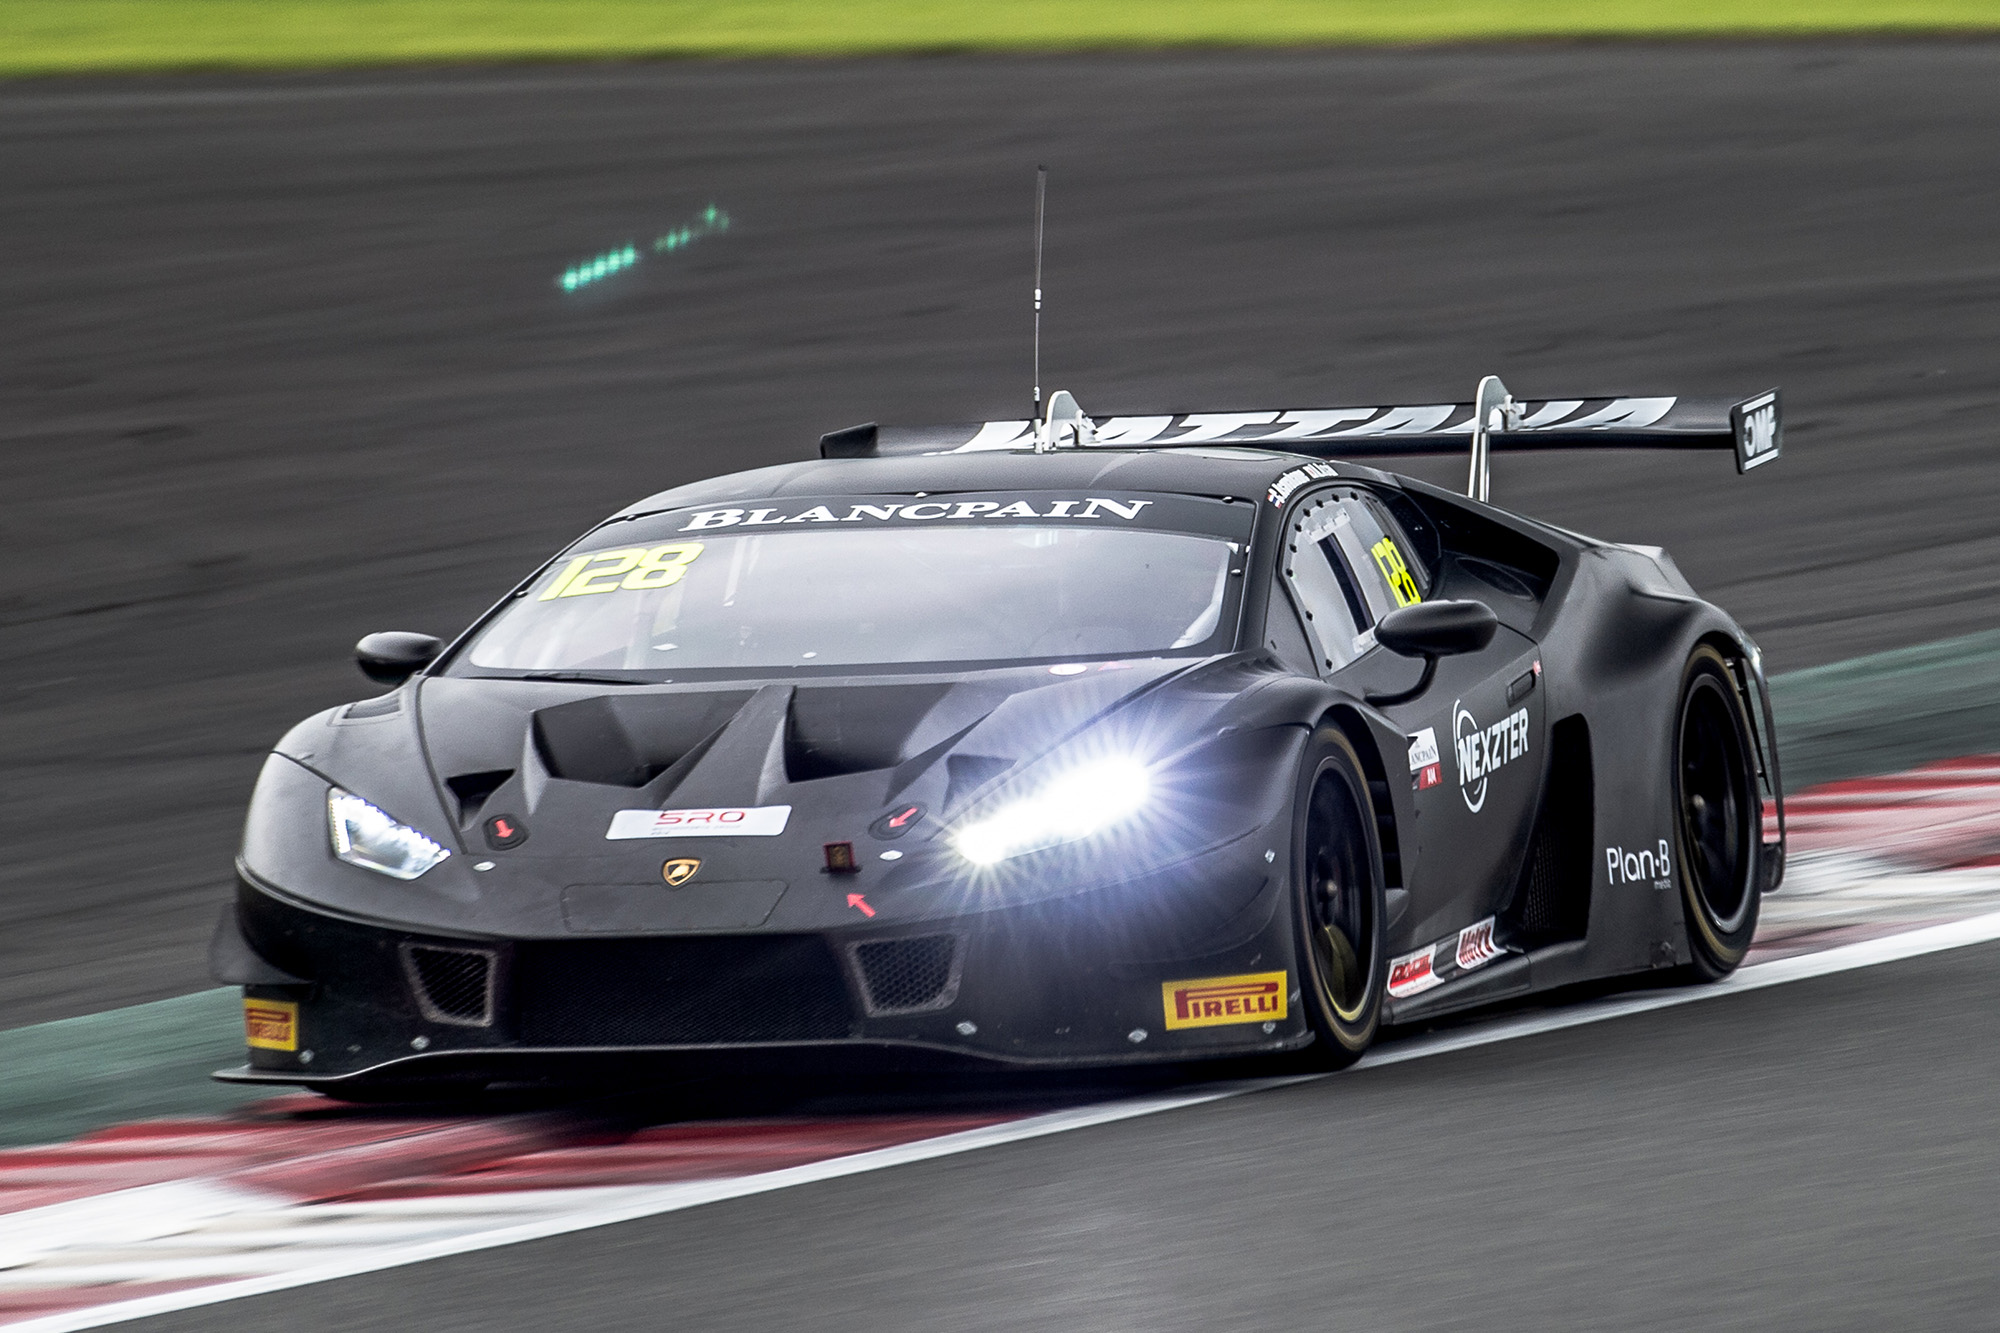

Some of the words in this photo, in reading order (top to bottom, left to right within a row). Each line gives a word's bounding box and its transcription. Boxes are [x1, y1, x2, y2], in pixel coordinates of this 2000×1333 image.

[677, 498, 1152, 532] BLANCPAIN
[538, 543, 704, 602] 128
[1370, 537, 1422, 609] 128
[1458, 706, 1529, 787] NEXZTER
[654, 810, 746, 826] SRO
[1174, 981, 1279, 1020] PIRELLI
